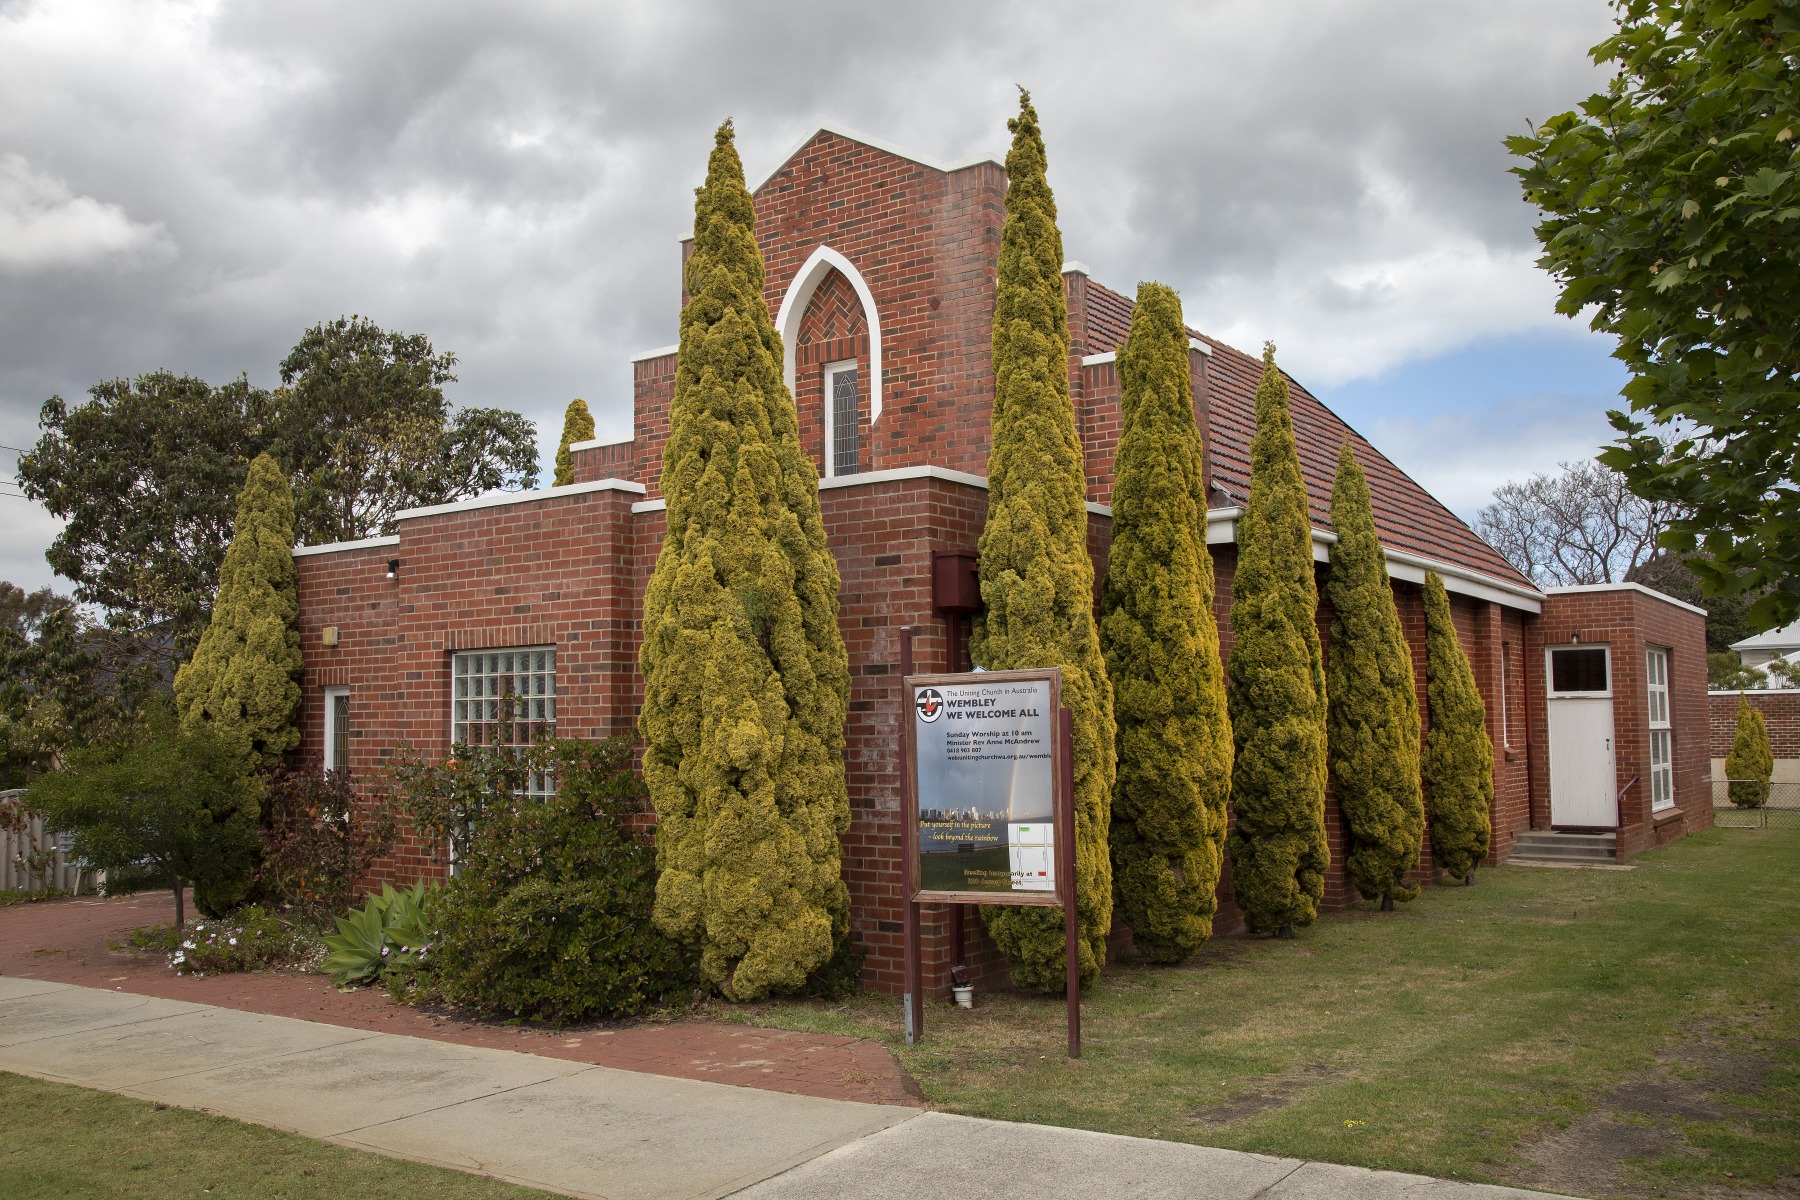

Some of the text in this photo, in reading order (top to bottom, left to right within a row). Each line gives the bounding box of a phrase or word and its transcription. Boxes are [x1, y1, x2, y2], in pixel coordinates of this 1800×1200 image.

[959, 689, 980, 698] Uniting
[981, 688, 1003, 696] Church
[1011, 686, 1038, 694] Australia
[946, 698, 997, 708] WEMBLEY
[946, 708, 1040, 720] WE WELCOME ALL
[946, 731, 970, 739] Sunday
[971, 730, 1001, 738] Worship
[919, 820, 991, 831] Put yourself in the picture
[932, 831, 945, 840] look
[945, 831, 965, 843] beyond
[965, 832, 974, 841] the
[974, 832, 999, 842] rainbow
